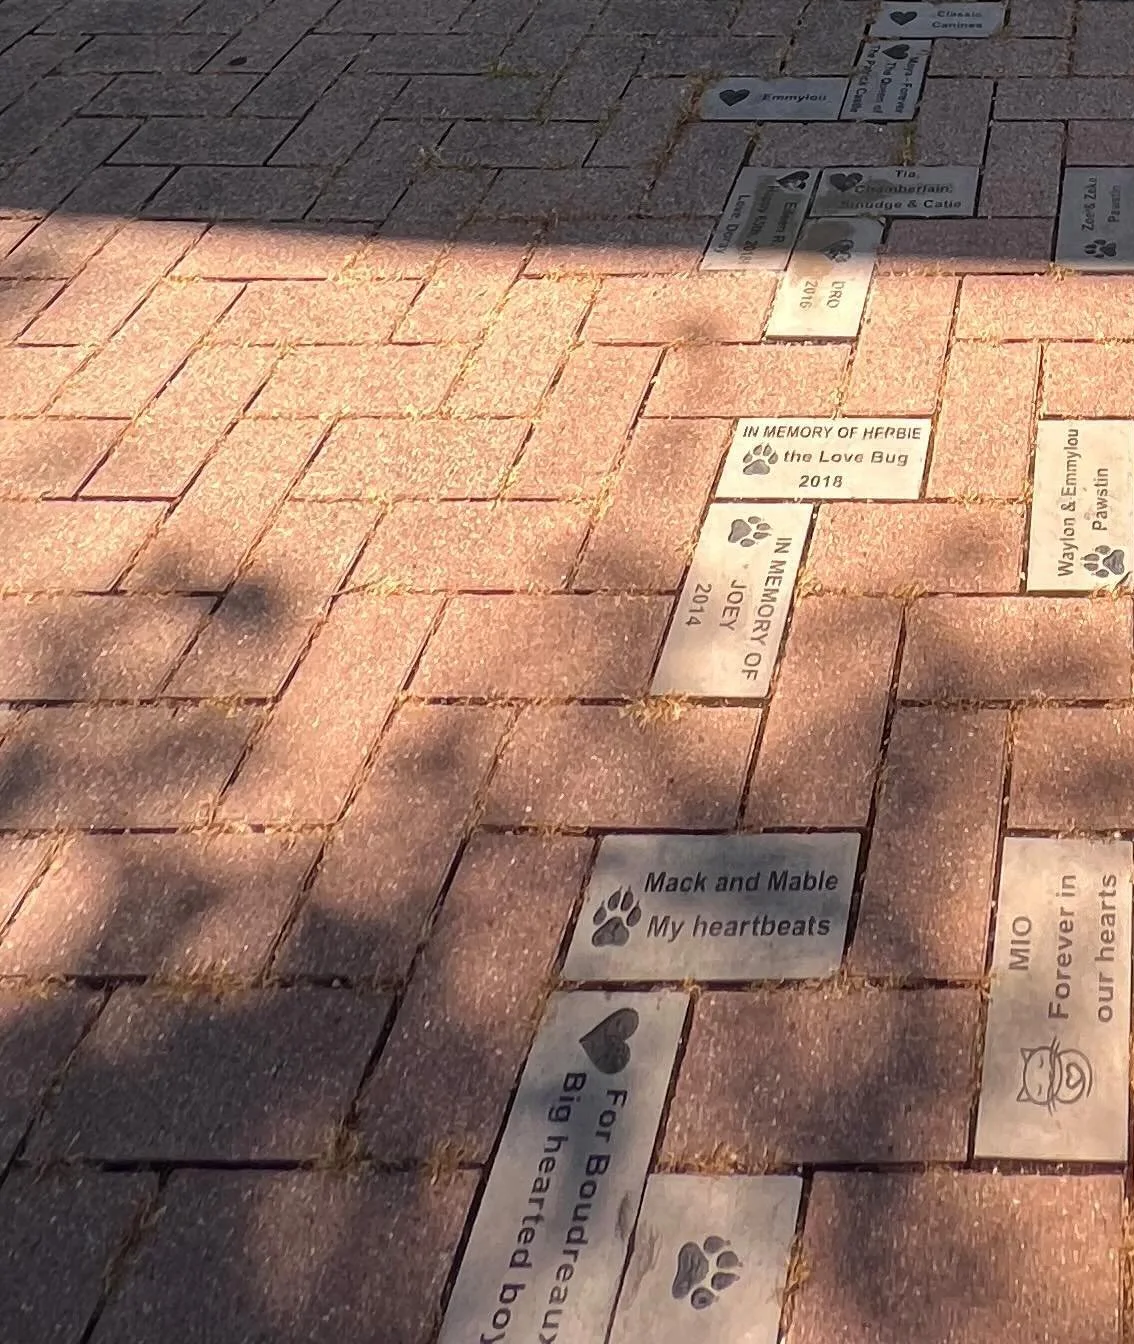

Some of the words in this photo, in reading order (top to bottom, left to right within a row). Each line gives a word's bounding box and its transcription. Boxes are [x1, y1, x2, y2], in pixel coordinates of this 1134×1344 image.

[932, 21, 983, 29] Canines
[936, 10, 983, 18] Classic
[762, 93, 828, 103] Emmylou
[907, 199, 918, 209] &
[799, 280, 819, 309] 2016
[743, 426, 758, 438] IN
[763, 426, 833, 439] MEMORY
[837, 426, 858, 439] OF
[783, 450, 813, 463] the
[819, 450, 864, 463] Love
[870, 451, 909, 467] Bug
[1061, 428, 1082, 497] Emmylou
[798, 475, 844, 489] 2018
[1061, 499, 1077, 512] &
[1092, 467, 1109, 532] Pawstin
[776, 537, 793, 554] IN
[1058, 517, 1080, 577] Waylon
[685, 583, 713, 627] 2014
[719, 579, 748, 632] JOEY
[749, 560, 787, 648] MEMORY
[741, 652, 763, 681] OF
[644, 871, 707, 893] Mack
[715, 871, 761, 892] and
[767, 870, 839, 891] Mable
[1056, 874, 1077, 898] in
[647, 915, 686, 943] My
[692, 915, 832, 938] heartbeats
[1095, 873, 1118, 962] hearts
[1008, 915, 1033, 971] MIO
[1048, 907, 1075, 1020] Forever
[1096, 972, 1114, 1023] our
[548, 1071, 587, 1124] Big
[594, 1089, 628, 1143] For
[510, 1136, 569, 1269] hearted
